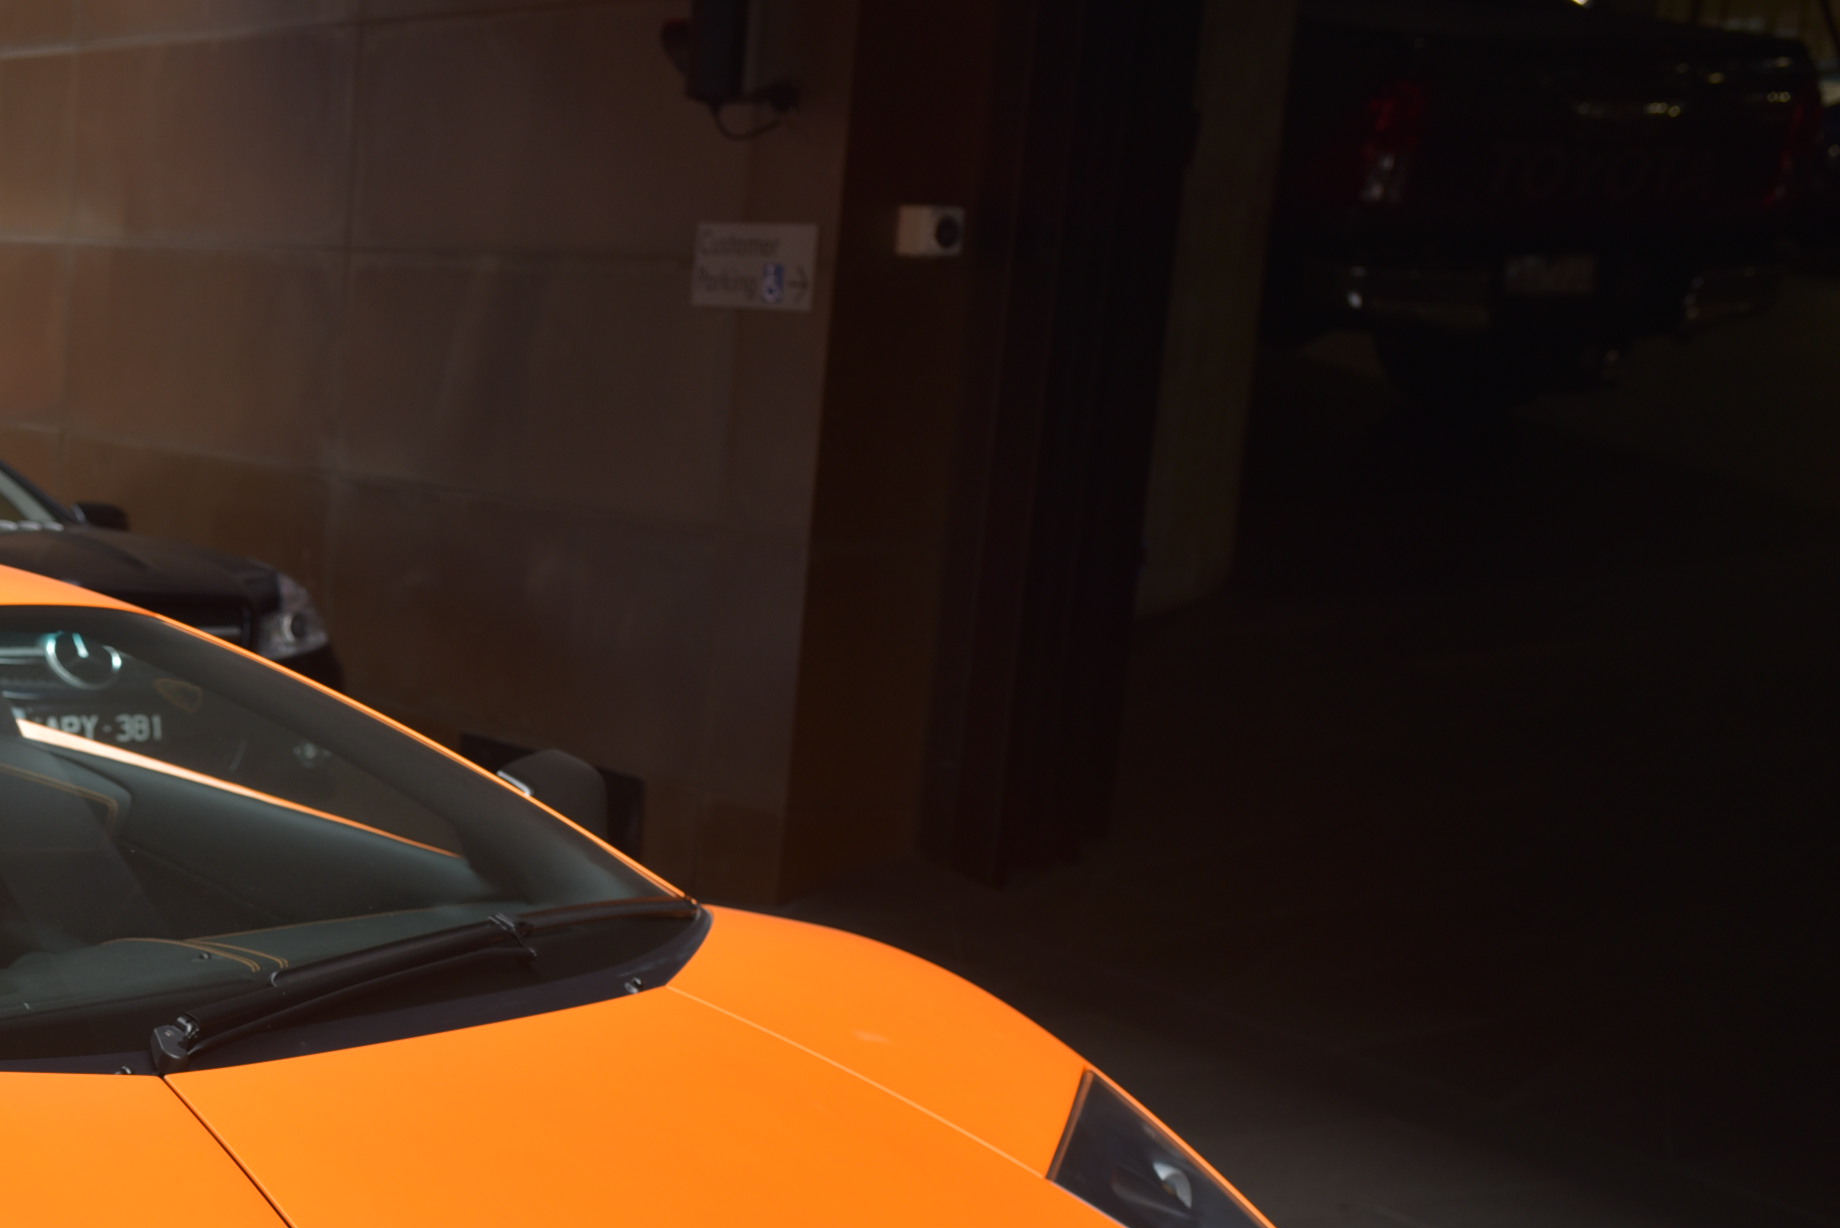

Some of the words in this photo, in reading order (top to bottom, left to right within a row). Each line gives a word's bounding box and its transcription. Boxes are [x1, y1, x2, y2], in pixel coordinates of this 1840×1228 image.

[1490, 143, 1716, 202] TOYOTA
[699, 228, 780, 257] Customer
[697, 264, 757, 299] Parking
